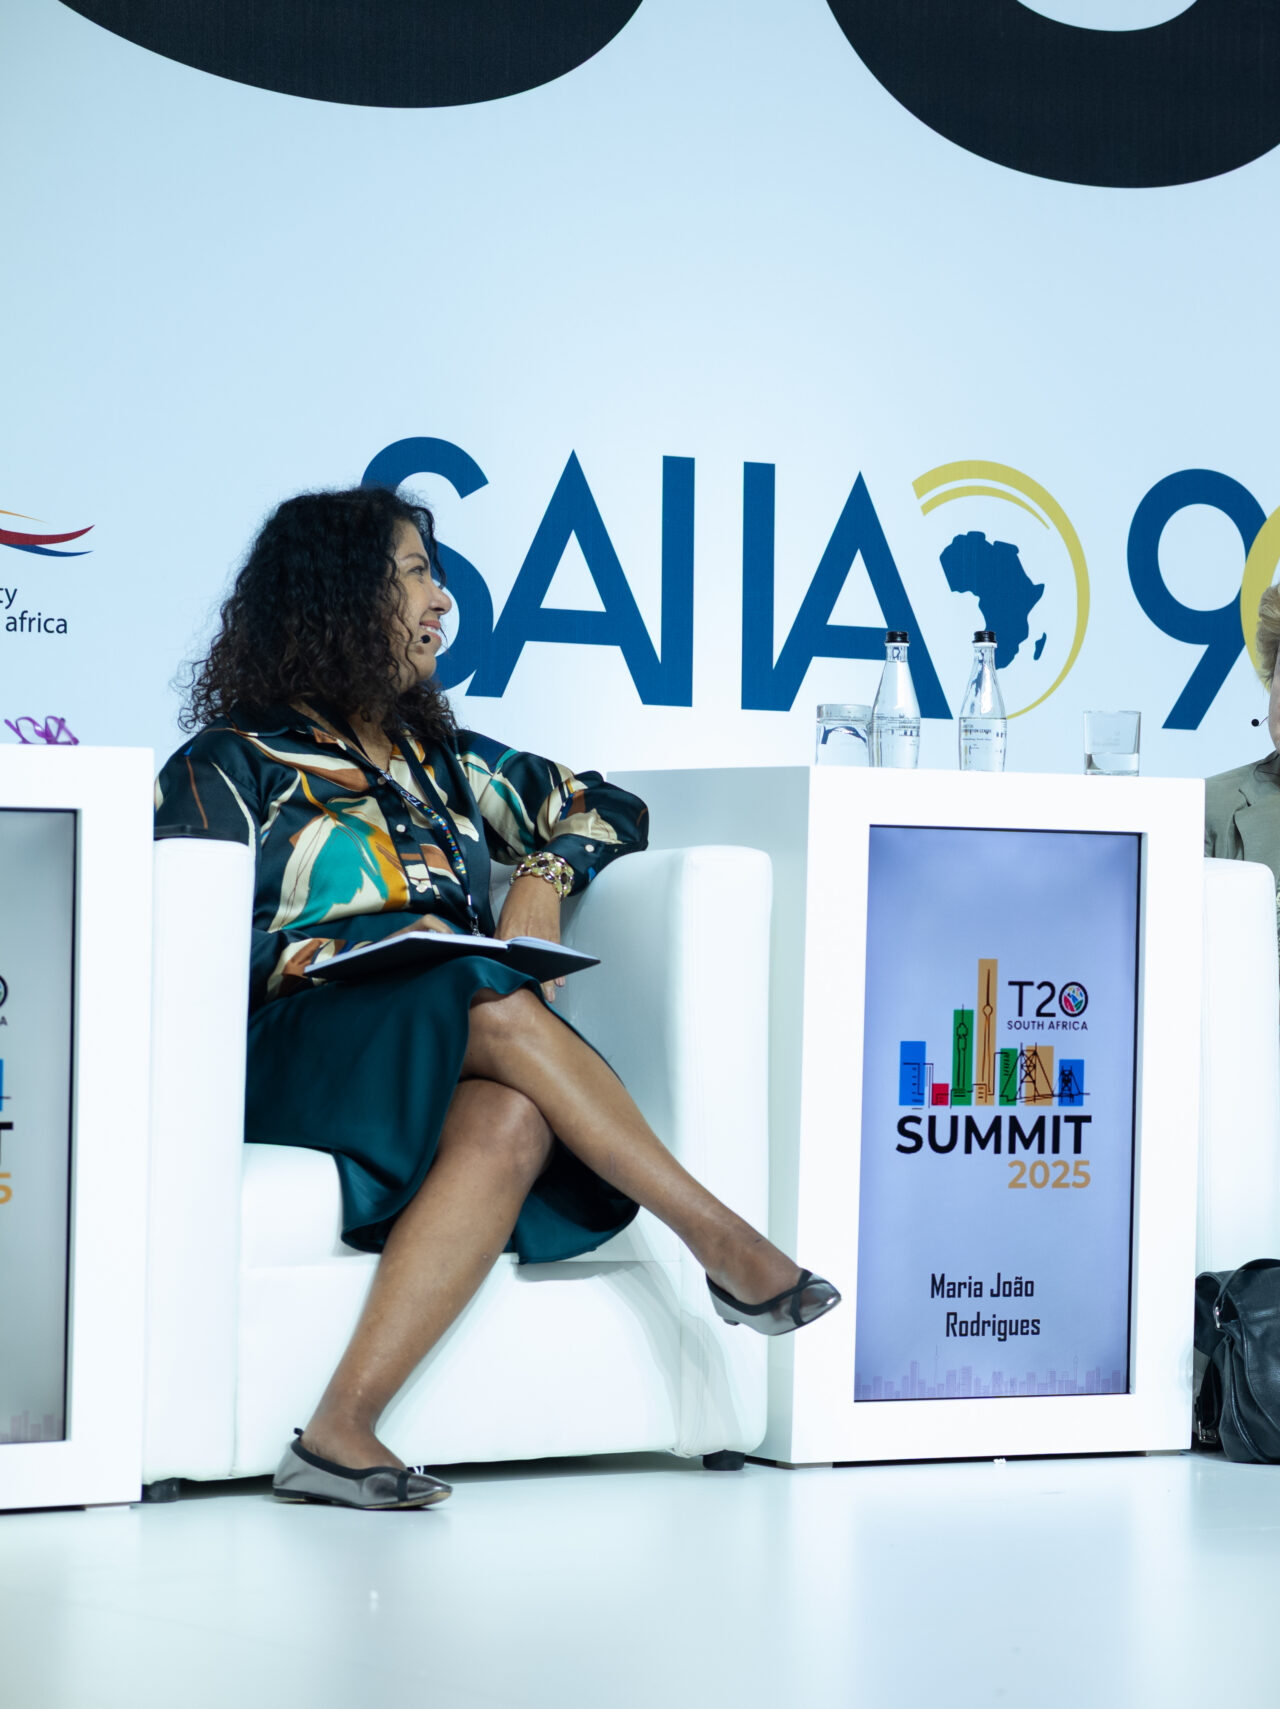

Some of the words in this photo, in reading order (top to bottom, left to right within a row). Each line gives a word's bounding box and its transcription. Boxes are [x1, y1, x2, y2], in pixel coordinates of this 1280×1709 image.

[361, 436, 953, 720] SAIIA
[5, 609, 69, 635] africa
[1007, 980, 1089, 1018] T20
[1007, 1020, 1045, 1031] SOUTH
[1047, 1020, 1089, 1031] AFRICA
[895, 1115, 1092, 1155] SUMMIT
[1008, 1159, 1092, 1189] 2025
[930, 1273, 983, 1299] Maria
[989, 1272, 1035, 1299] João
[945, 1311, 1041, 1342] Rodrigues
